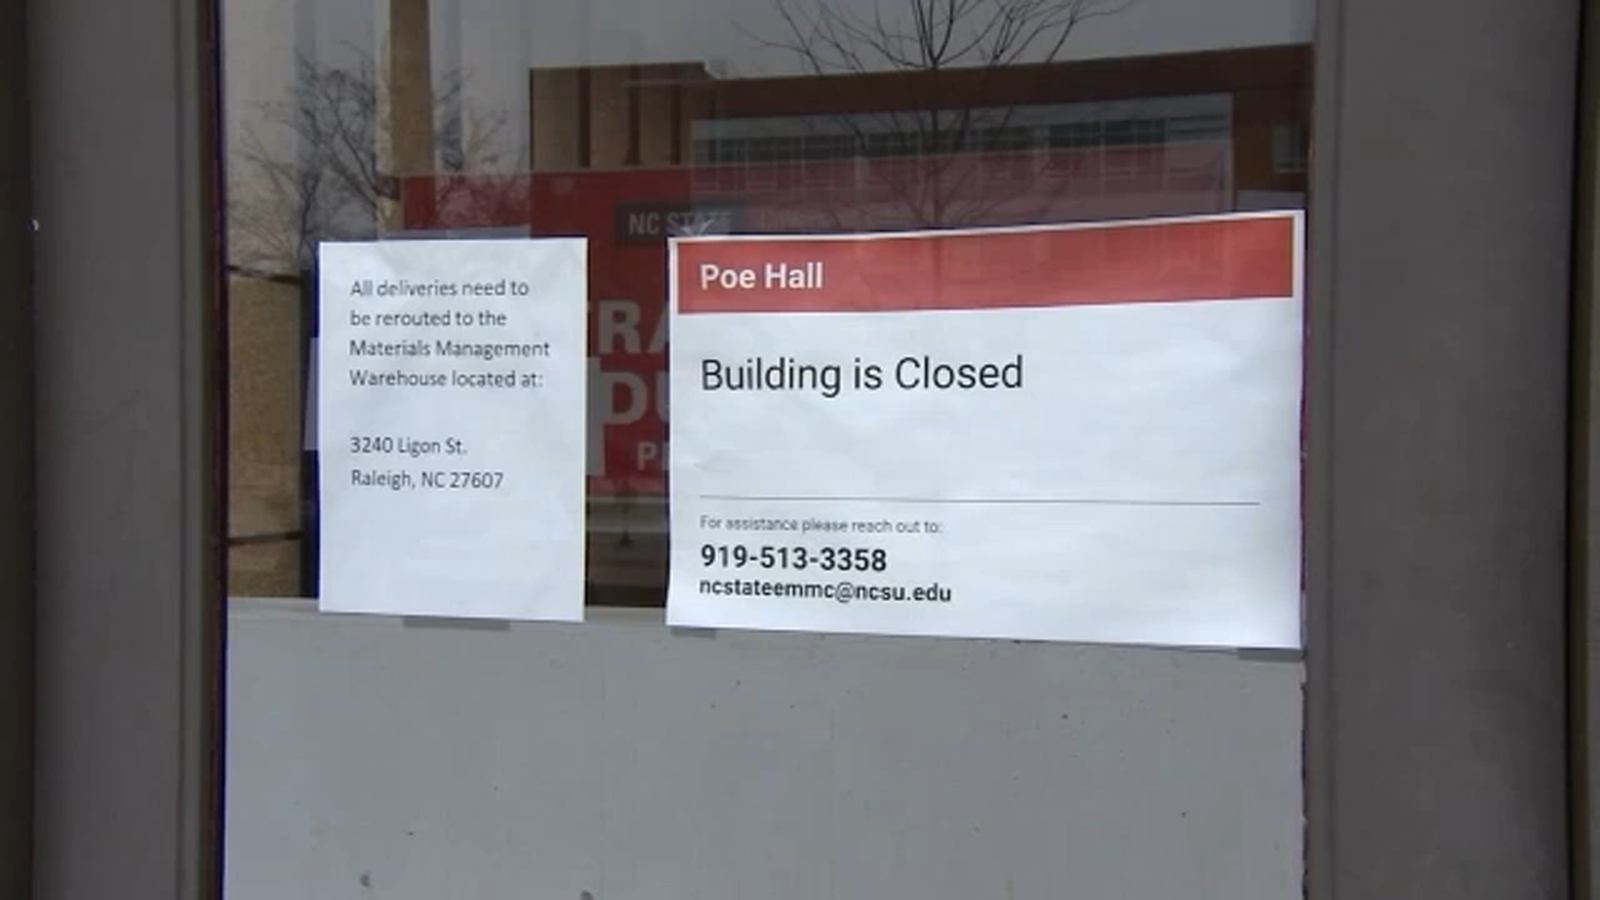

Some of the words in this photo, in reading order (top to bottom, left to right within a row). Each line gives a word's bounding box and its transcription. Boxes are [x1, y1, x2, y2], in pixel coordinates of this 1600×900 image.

[628, 212, 661, 236] NC
[700, 263, 757, 291] Poe
[764, 261, 823, 290] Hall
[350, 280, 374, 298] All
[376, 279, 459, 298] deliveries
[461, 279, 507, 297] need
[510, 281, 530, 297] to
[350, 309, 372, 327] be
[375, 310, 452, 327] rerouted
[455, 311, 475, 327] to
[478, 310, 507, 327] the
[349, 340, 431, 357] Materials
[435, 340, 550, 361] Management
[350, 369, 448, 387] Warehouse
[451, 369, 517, 388] located
[520, 372, 544, 388] at:
[701, 355, 842, 398] Building
[853, 356, 884, 392] is
[895, 353, 1024, 391] Closed
[350, 436, 394, 454] 3240
[397, 436, 442, 459] Ligon
[445, 436, 468, 455] St.
[351, 469, 416, 491] Raleigh,
[421, 471, 446, 489] NC
[448, 471, 504, 489] 27607
[699, 515, 722, 530] For
[725, 517, 798, 532] assistance
[801, 517, 849, 535] please
[851, 518, 893, 533] reach
[895, 520, 920, 533] out
[923, 520, 943, 534] to:
[700, 543, 888, 573] 919-513-3358
[699, 577, 952, 604] ncstateemmc@ncsu.edu
